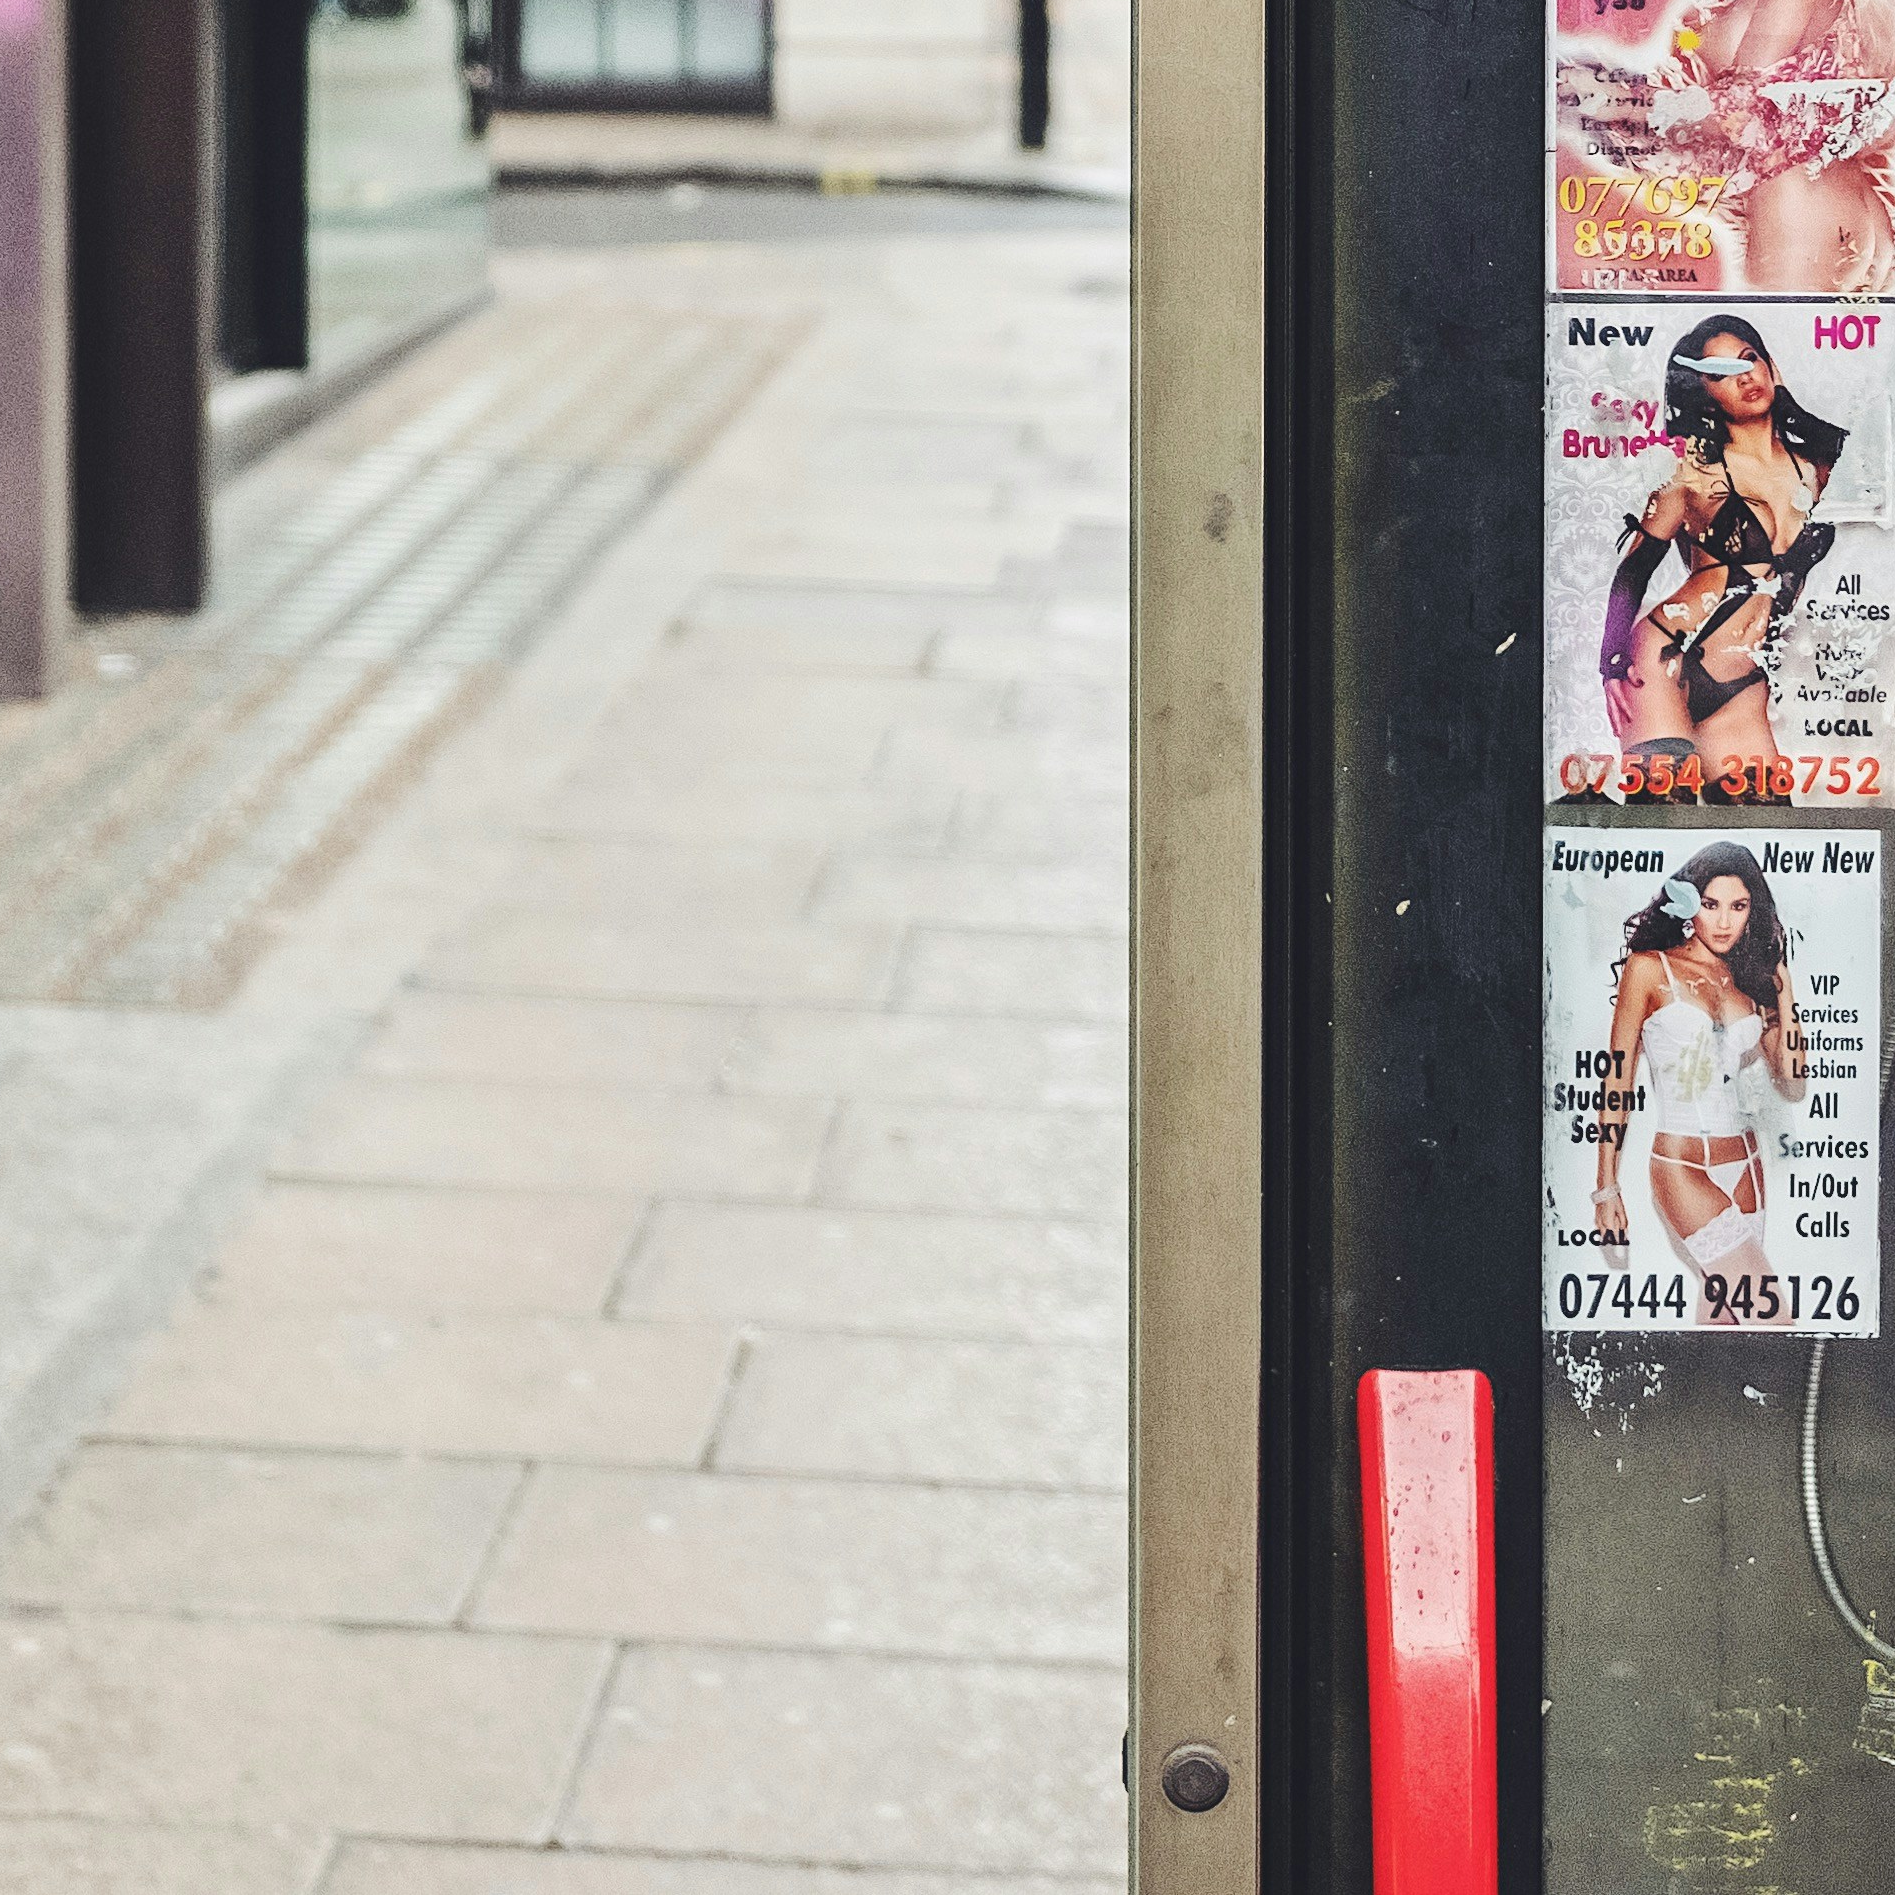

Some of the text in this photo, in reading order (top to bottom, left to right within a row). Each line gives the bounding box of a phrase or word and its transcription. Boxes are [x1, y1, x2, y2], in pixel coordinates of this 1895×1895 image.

[1559, 176, 1728, 218] 077697
[1568, 316, 1881, 351] New HOT
[1835, 574, 1861, 595] All
[1806, 599, 1891, 621] Services
[1796, 684, 1887, 703] Avaable
[1805, 718, 1874, 737] LOCAL
[1560, 754, 1882, 797] 07554 318752
[1552, 839, 1875, 878] European New New
[1809, 974, 1841, 996] VIP
[1790, 1002, 1860, 1025] Services
[1786, 1029, 1864, 1053] Uniforms
[1575, 1050, 1626, 1080] HOT
[1792, 1059, 1857, 1080] Lesbian
[1553, 1082, 1646, 1113] Student
[1808, 1093, 1840, 1120] All
[1570, 1114, 1628, 1151] Sexy
[1778, 1133, 1870, 1159] Services
[1558, 1228, 1631, 1247] LOCAL
[1795, 1212, 1851, 1239] Calls
[1558, 1272, 1861, 1322] 07444 945126
